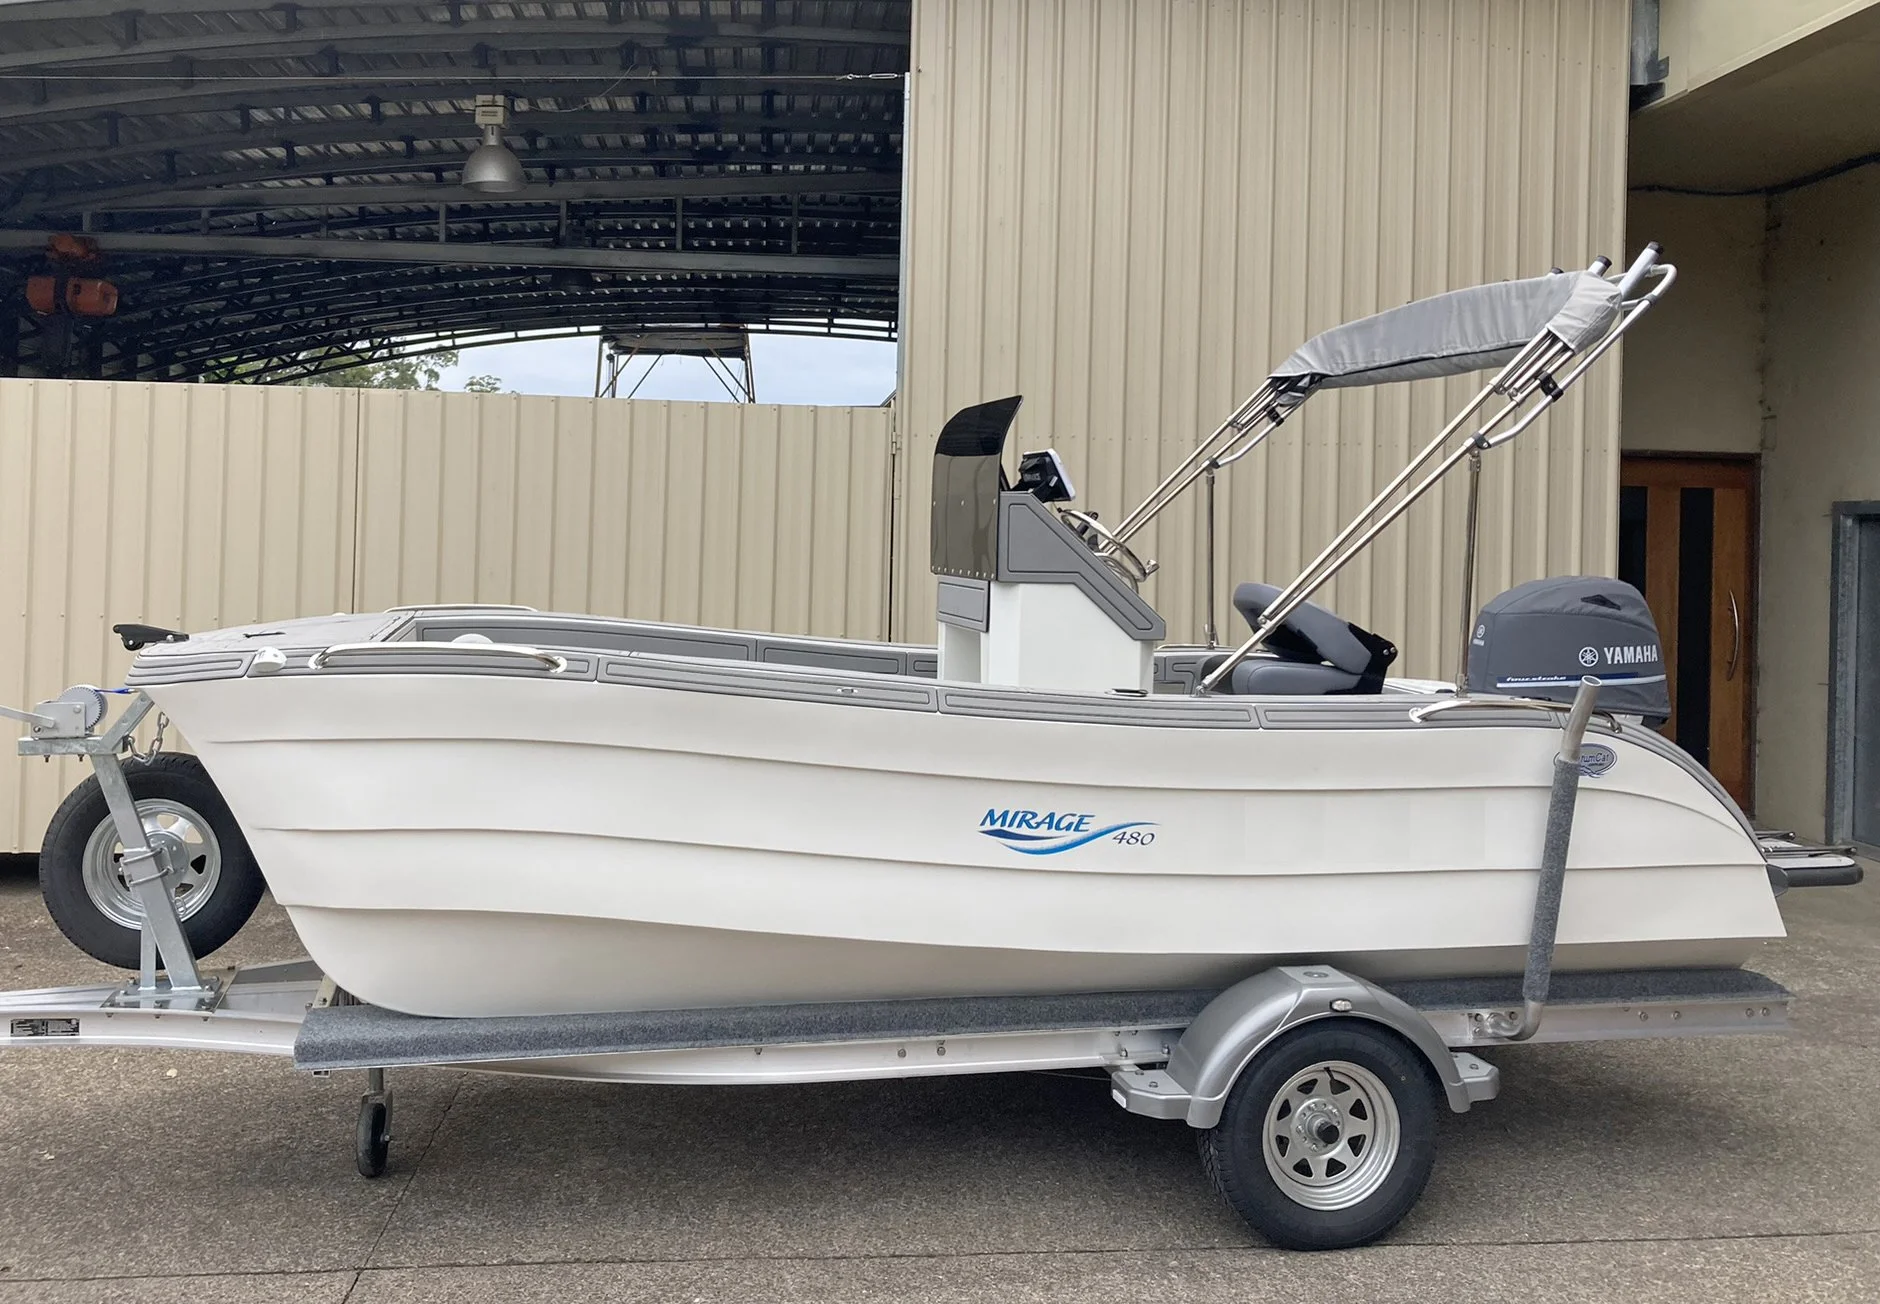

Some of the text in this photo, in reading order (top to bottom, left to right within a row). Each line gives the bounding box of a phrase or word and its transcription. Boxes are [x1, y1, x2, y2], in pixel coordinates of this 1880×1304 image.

[1603, 644, 1658, 664] YAMAHA
[979, 808, 1155, 846] MIRAGE 480
